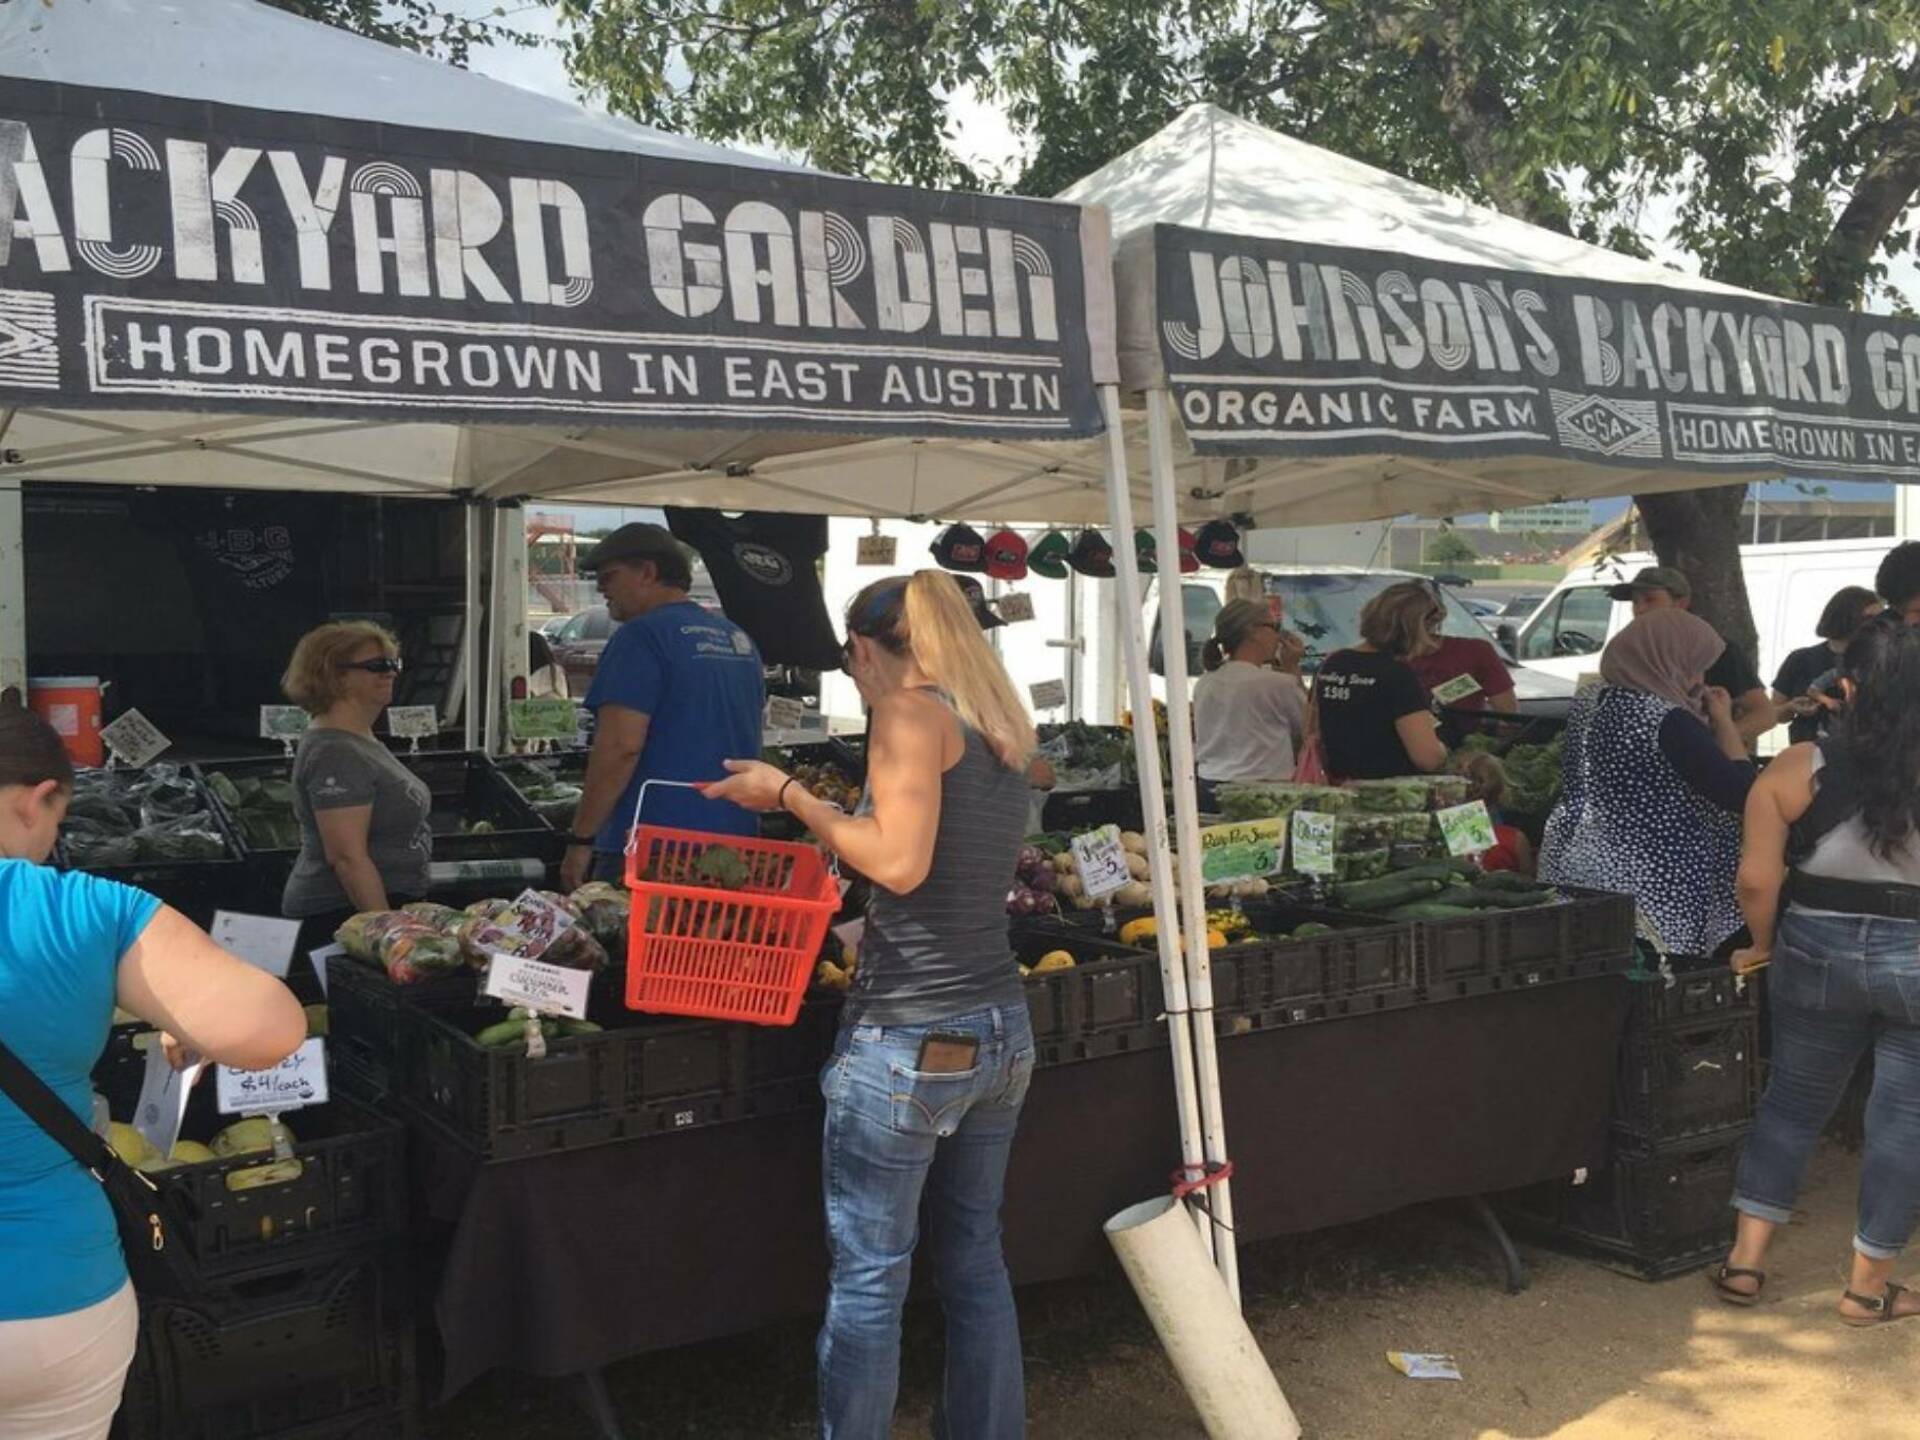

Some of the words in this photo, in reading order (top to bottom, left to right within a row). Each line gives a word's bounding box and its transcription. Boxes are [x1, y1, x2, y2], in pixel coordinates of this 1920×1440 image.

[641, 192, 1060, 342] GARDEN
[126, 322, 602, 393] HOMEGROWN
[627, 352, 699, 396] IN
[723, 356, 861, 403] EAST
[880, 364, 1062, 412] AUSTIN
[1573, 294, 1852, 405] BACKYARD
[1183, 389, 1398, 426] ORGANIC
[1411, 397, 1538, 430] FARM
[1582, 408, 1626, 443] CSA
[1678, 419, 1856, 458] HOMEGROWN
[1863, 433, 1896, 463] IN
